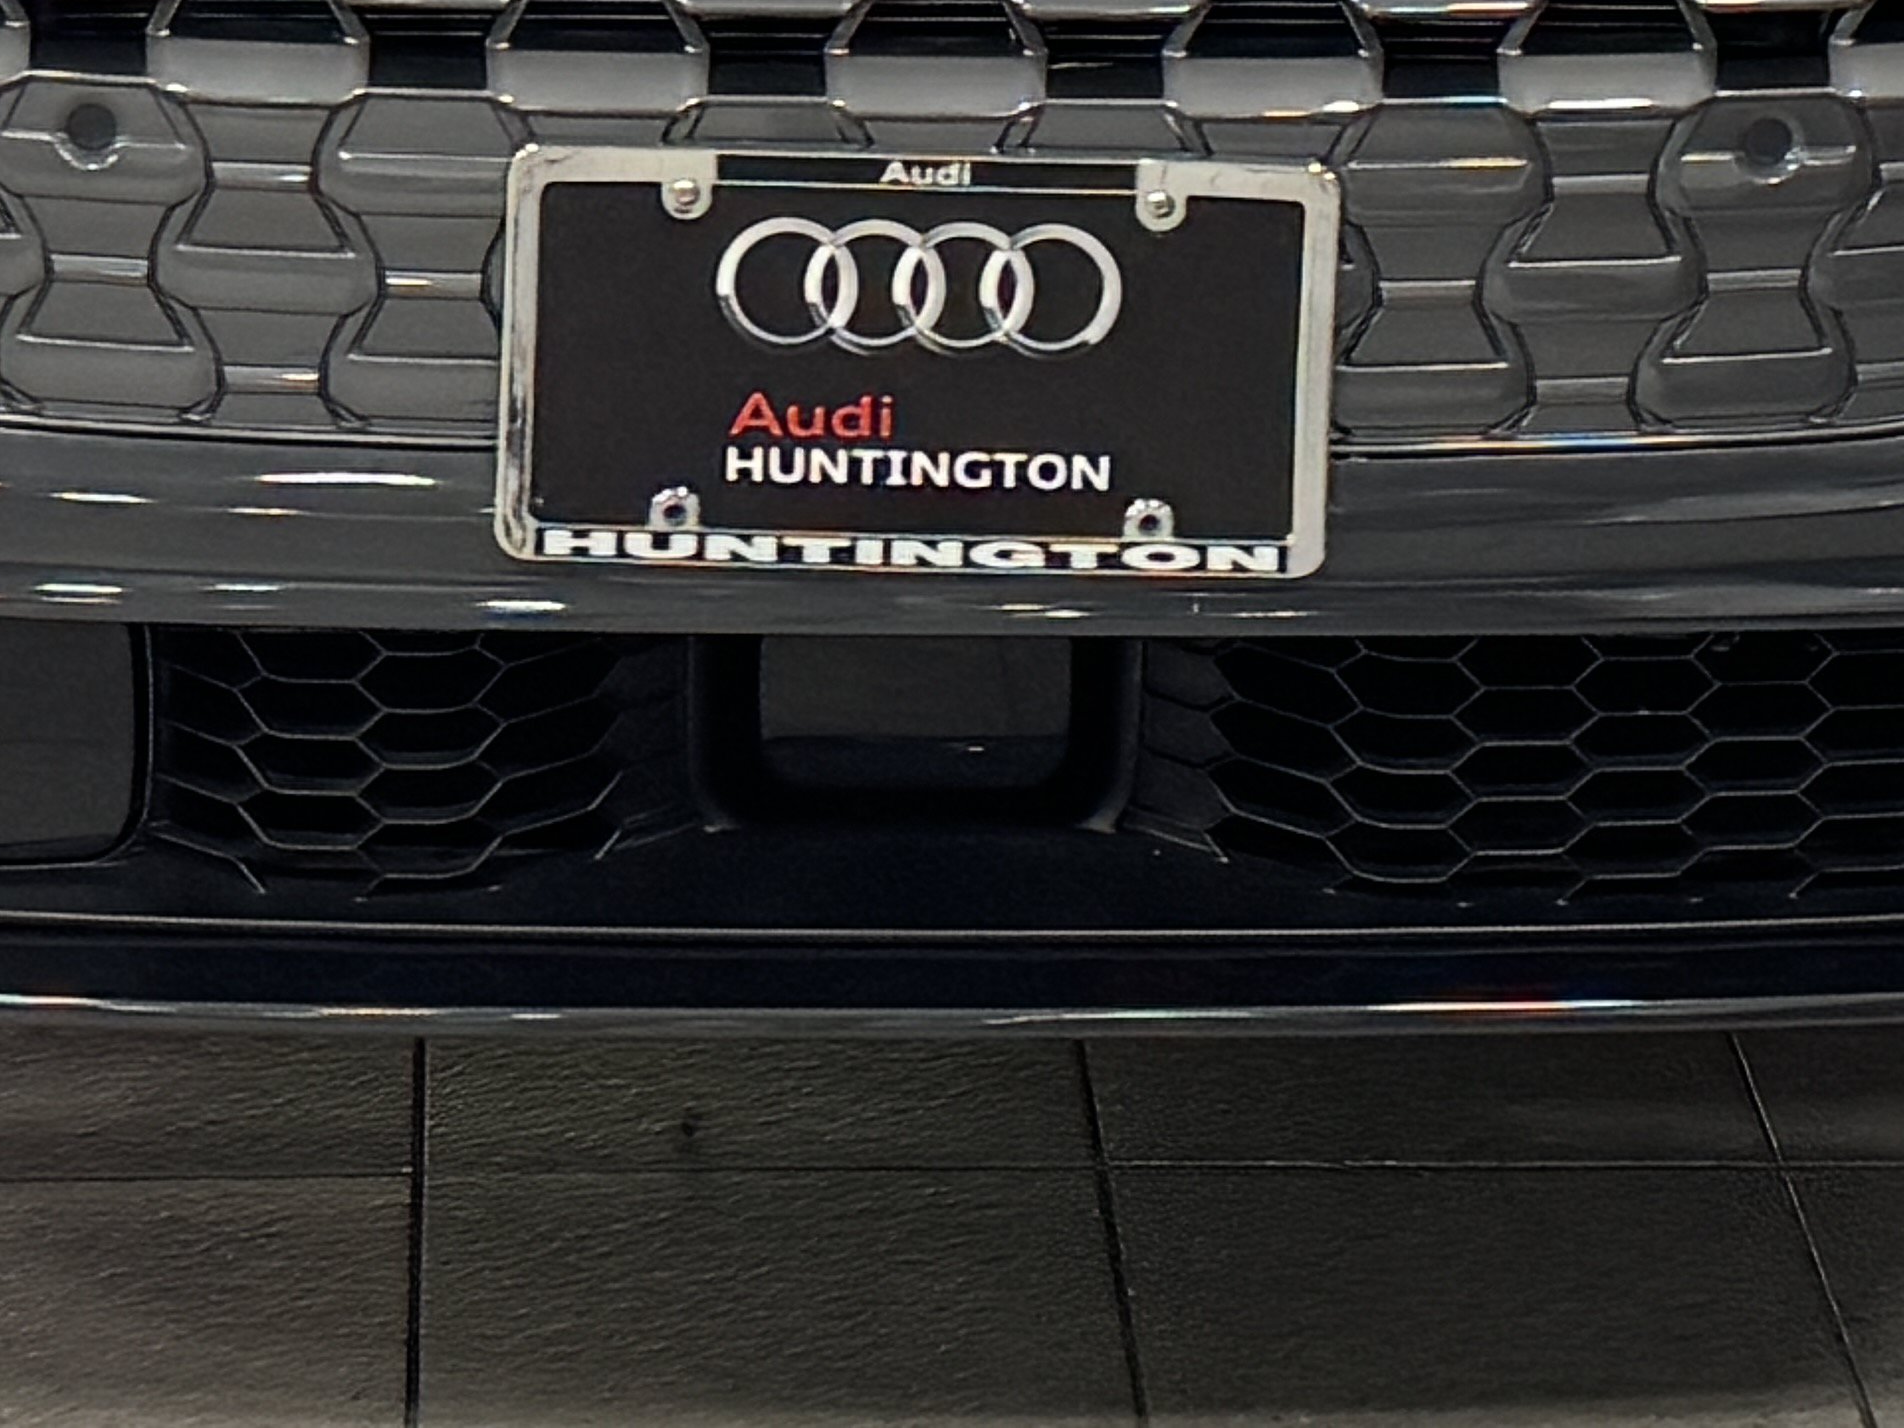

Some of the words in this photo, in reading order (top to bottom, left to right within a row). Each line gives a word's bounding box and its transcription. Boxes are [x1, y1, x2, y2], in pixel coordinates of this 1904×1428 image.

[879, 161, 971, 186] Audi
[728, 390, 894, 439] Audi
[724, 445, 1112, 492] HUNTINGTON
[542, 529, 1281, 573] HUNTINGTON
